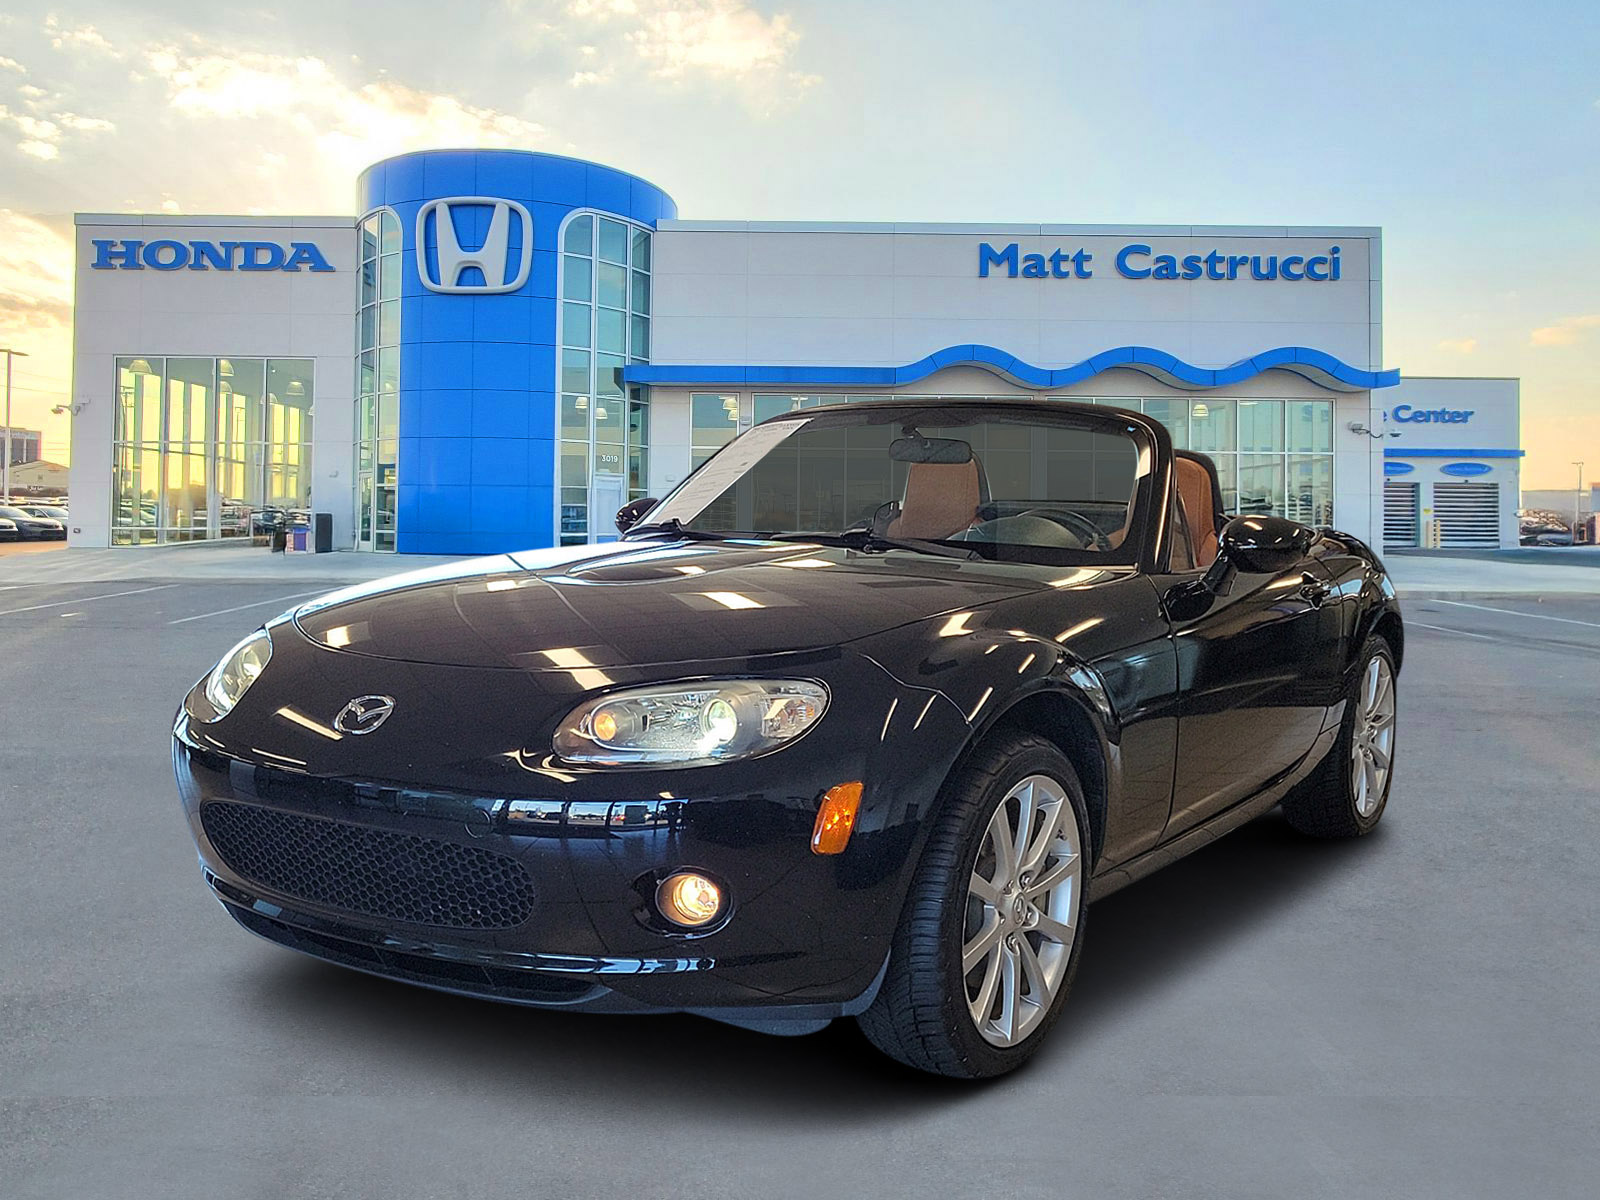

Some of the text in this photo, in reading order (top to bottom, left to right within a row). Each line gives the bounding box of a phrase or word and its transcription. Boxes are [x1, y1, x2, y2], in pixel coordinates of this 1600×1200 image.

[91, 239, 336, 272] HONDA
[978, 243, 1342, 281] Matt Castrucci
[1391, 404, 1475, 424] Center
[601, 454, 618, 463] 3019
